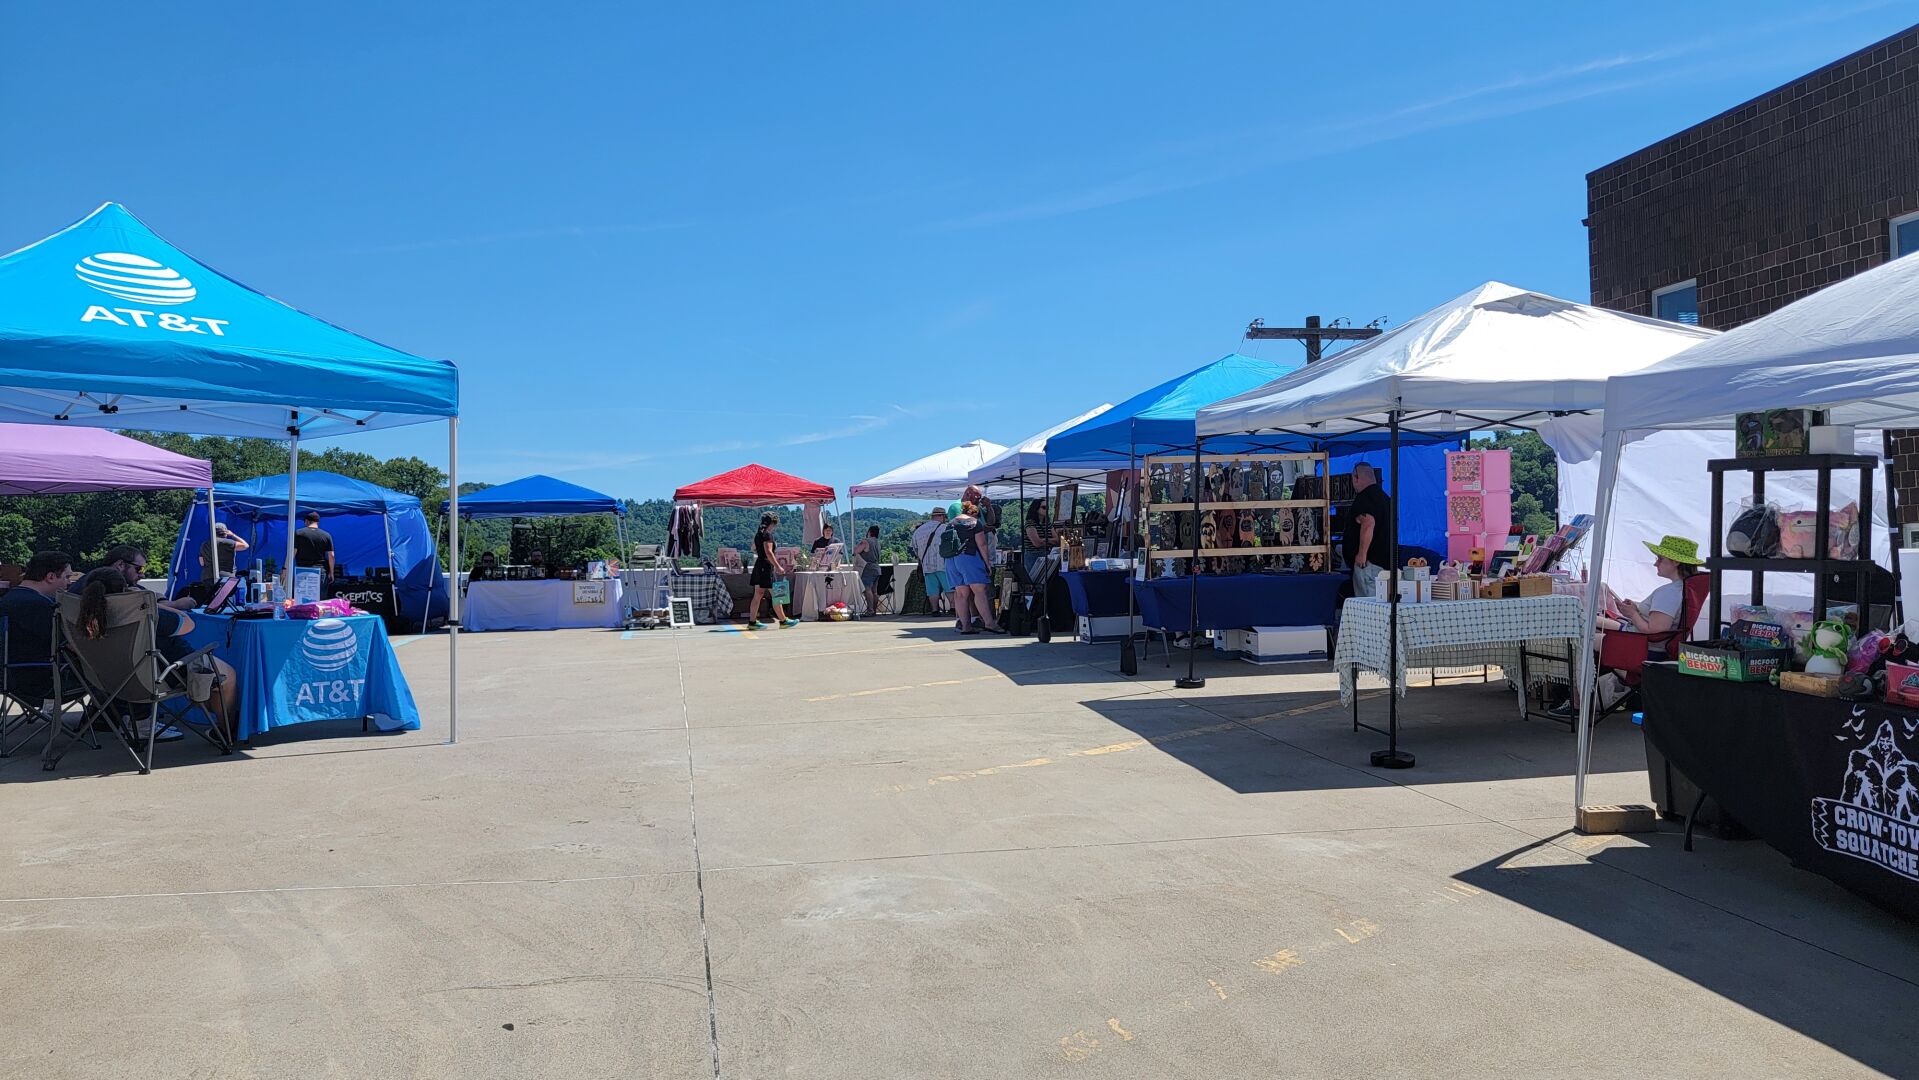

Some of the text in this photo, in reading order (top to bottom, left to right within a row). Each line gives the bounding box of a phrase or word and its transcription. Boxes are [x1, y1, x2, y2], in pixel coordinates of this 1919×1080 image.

[80, 305, 229, 336] AT&T
[1751, 623, 1781, 631] BIGFOOT
[1686, 651, 1721, 663] BIGFOOT
[1686, 659, 1722, 673] BENDY
[295, 679, 365, 706] AT&T
